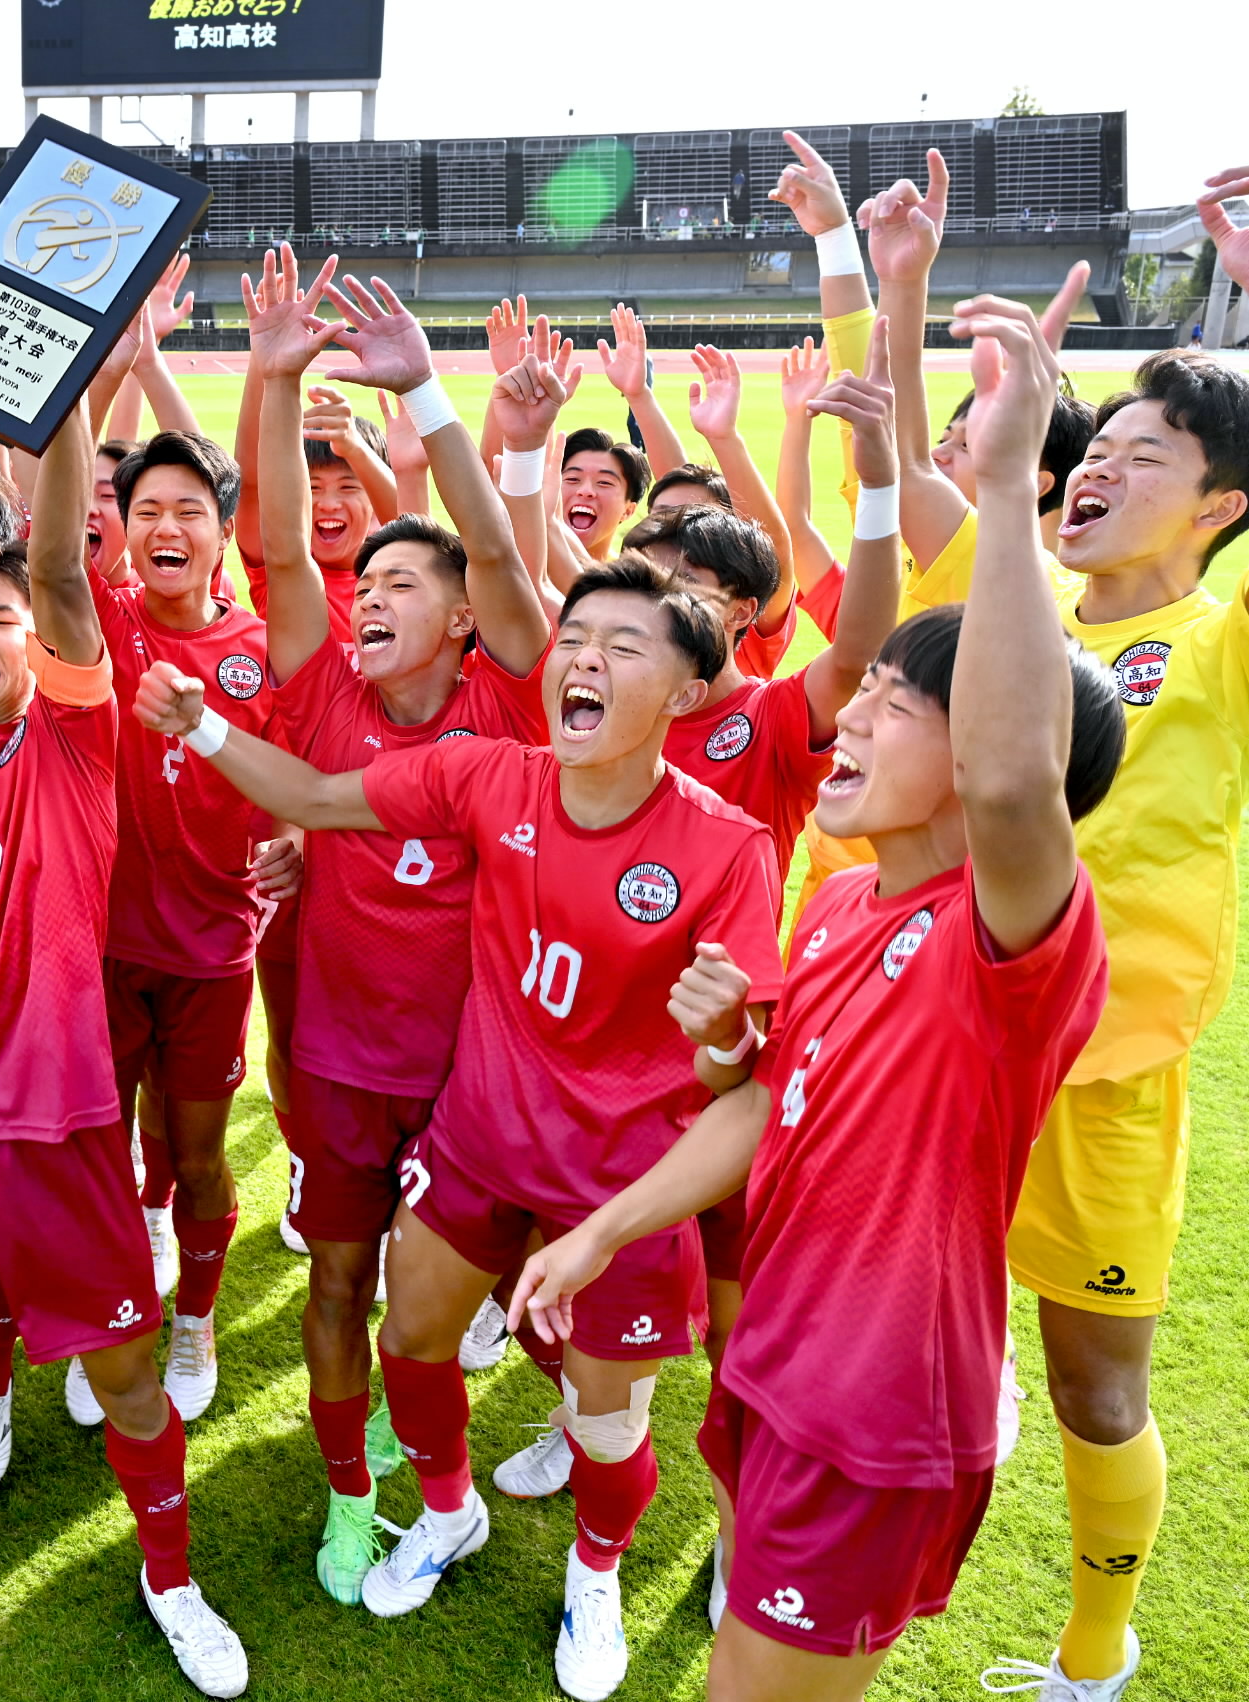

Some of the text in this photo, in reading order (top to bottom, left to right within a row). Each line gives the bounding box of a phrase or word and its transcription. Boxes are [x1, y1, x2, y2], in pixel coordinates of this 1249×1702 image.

[173, 22, 278, 50] 高知高校
[60, 159, 143, 210] 優勝
[15, 366, 44, 384] meiji
[229, 669, 253, 682] 高知
[1128, 665, 1162, 682] 高知
[715, 730, 739, 746] 高知
[498, 832, 537, 858] Desporte
[633, 883, 664, 901] 高知
[520, 927, 583, 1019] 10
[1084, 1279, 1137, 1296] Desporte
[108, 1312, 143, 1329] Desporte
[621, 1331, 662, 1346] Desporte
[756, 1597, 816, 1631] Desporte
